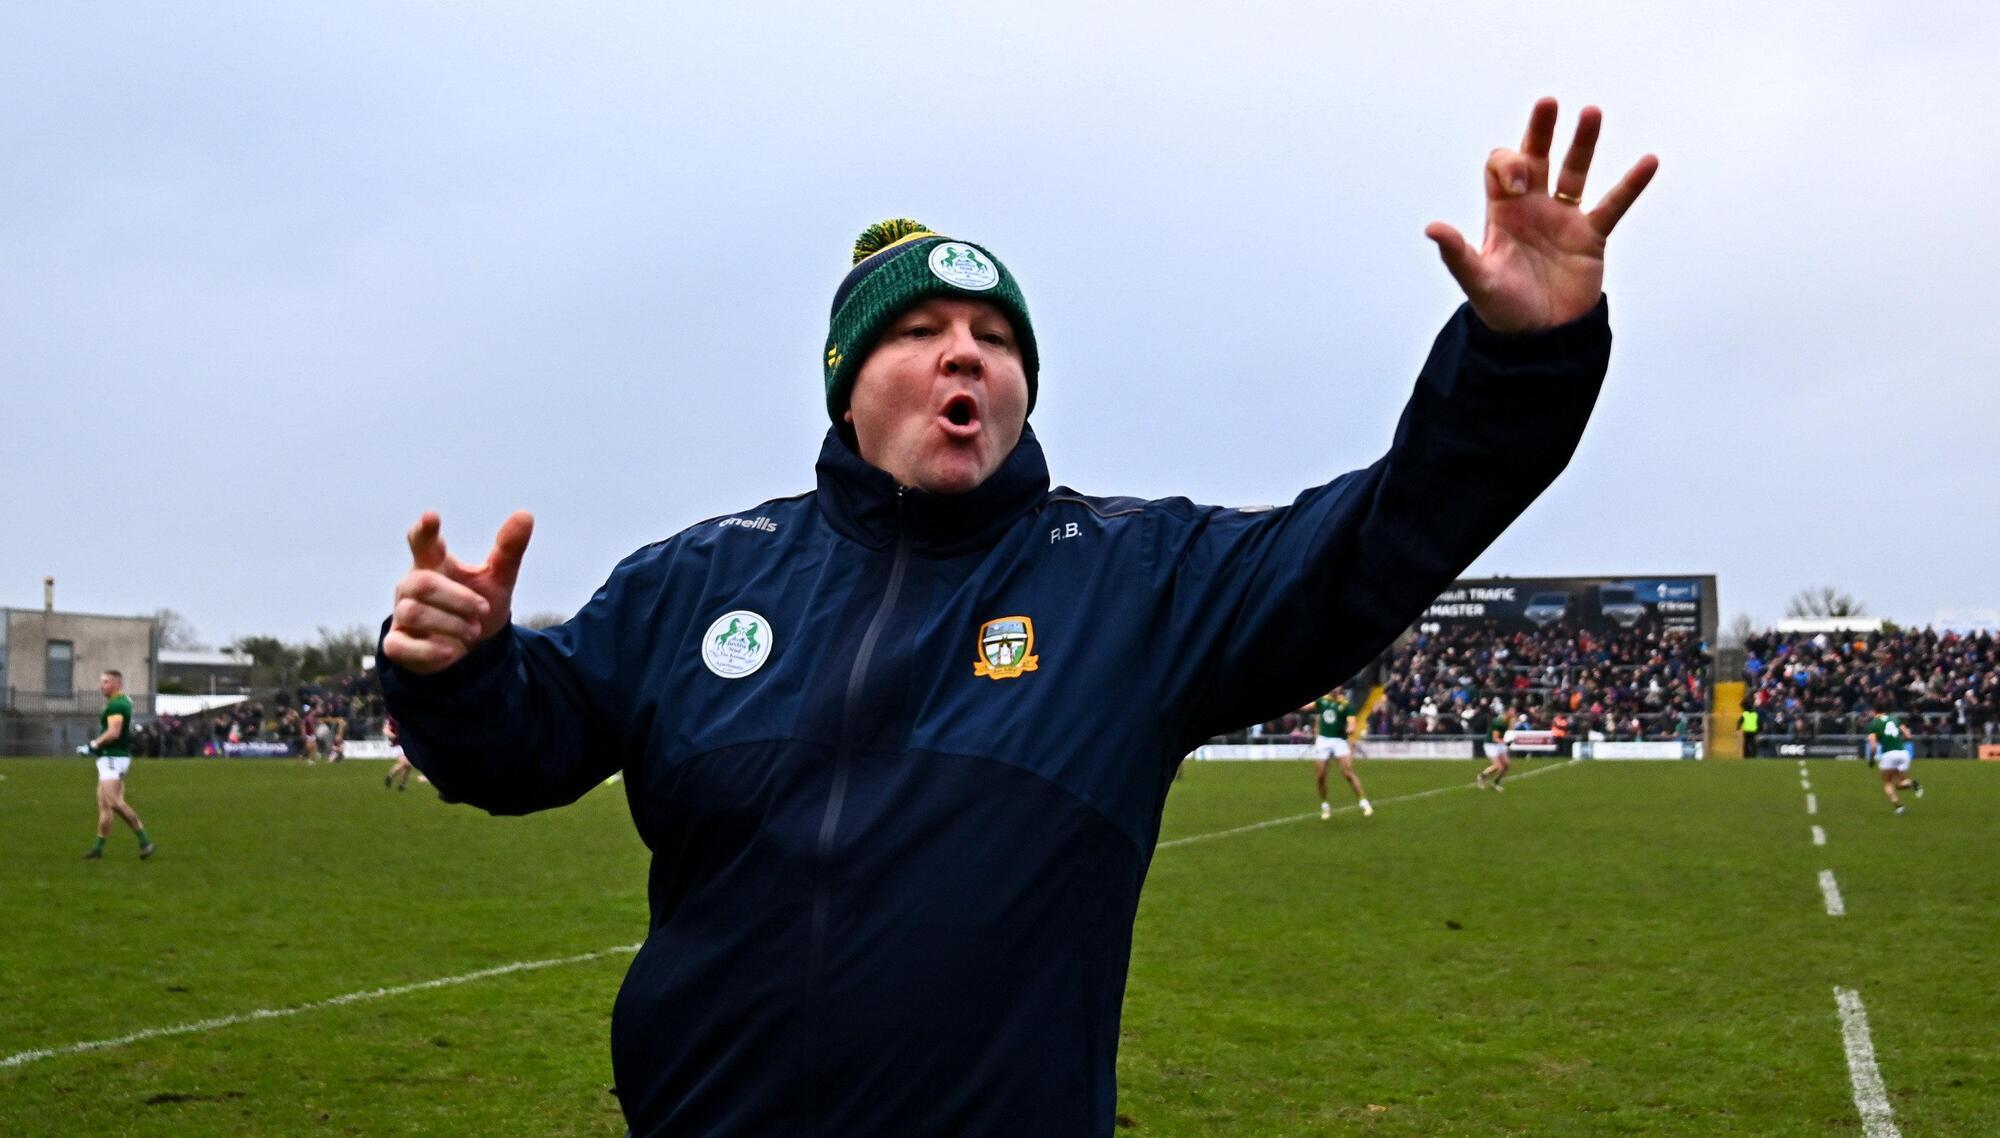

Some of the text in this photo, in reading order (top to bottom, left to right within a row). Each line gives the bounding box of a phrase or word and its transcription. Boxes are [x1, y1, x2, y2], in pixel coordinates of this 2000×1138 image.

[1469, 587, 1516, 601] TRAFIC
[1430, 603, 1484, 617] MASTER
[1884, 720, 1899, 738] 4
